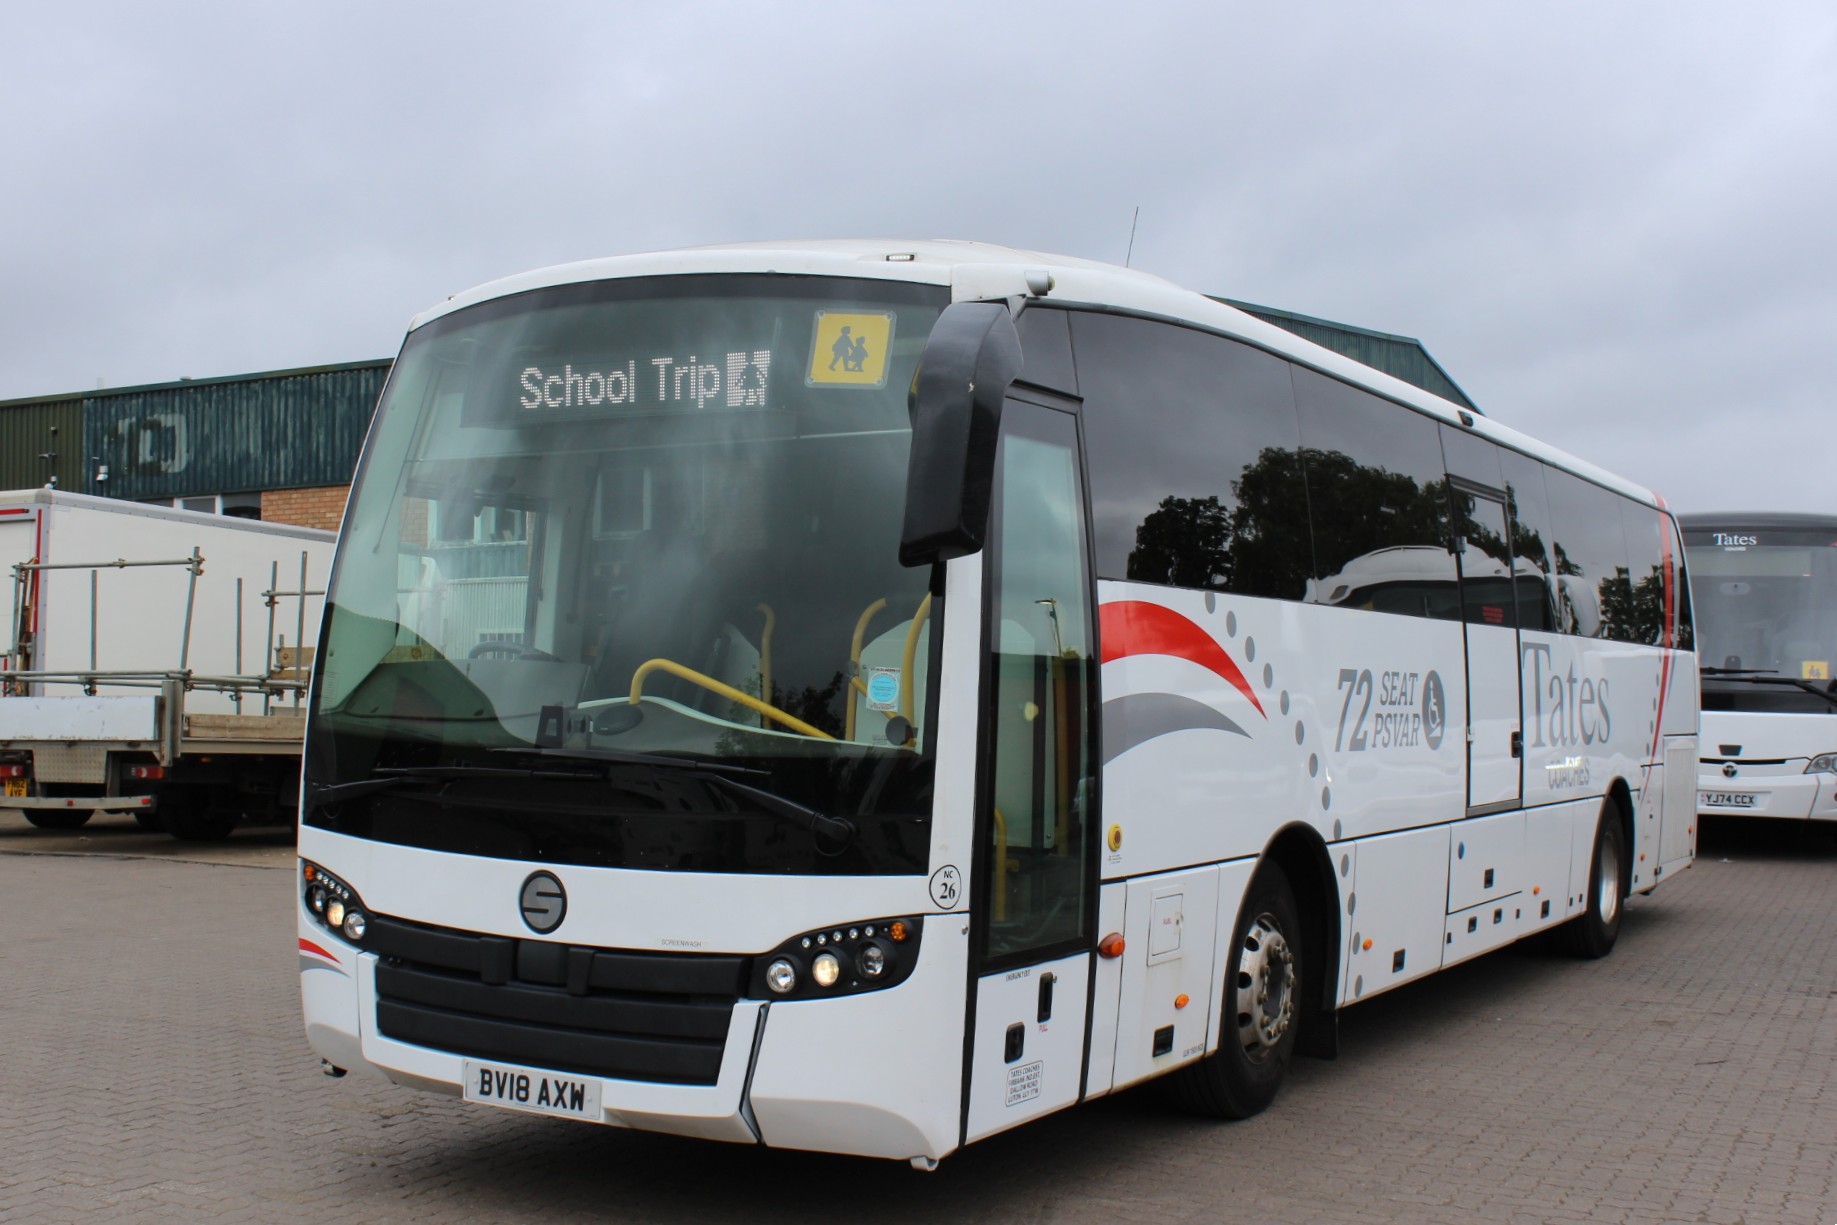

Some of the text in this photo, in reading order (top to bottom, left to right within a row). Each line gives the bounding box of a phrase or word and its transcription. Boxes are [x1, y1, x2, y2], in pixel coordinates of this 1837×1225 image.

[520, 355, 720, 409] School Trip
[1712, 533, 1757, 546] Tates
[1380, 671, 1418, 706] SEAT
[1521, 641, 1610, 748] Tates
[1335, 668, 1373, 753] 72
[1371, 713, 1420, 748] PSVAR
[1706, 794, 1754, 804] YJ74 CCX
[939, 882, 956, 899] 26
[943, 870, 954, 879] NC
[661, 939, 702, 947] SCREENWASH
[479, 1068, 585, 1111] BV18 AXW
